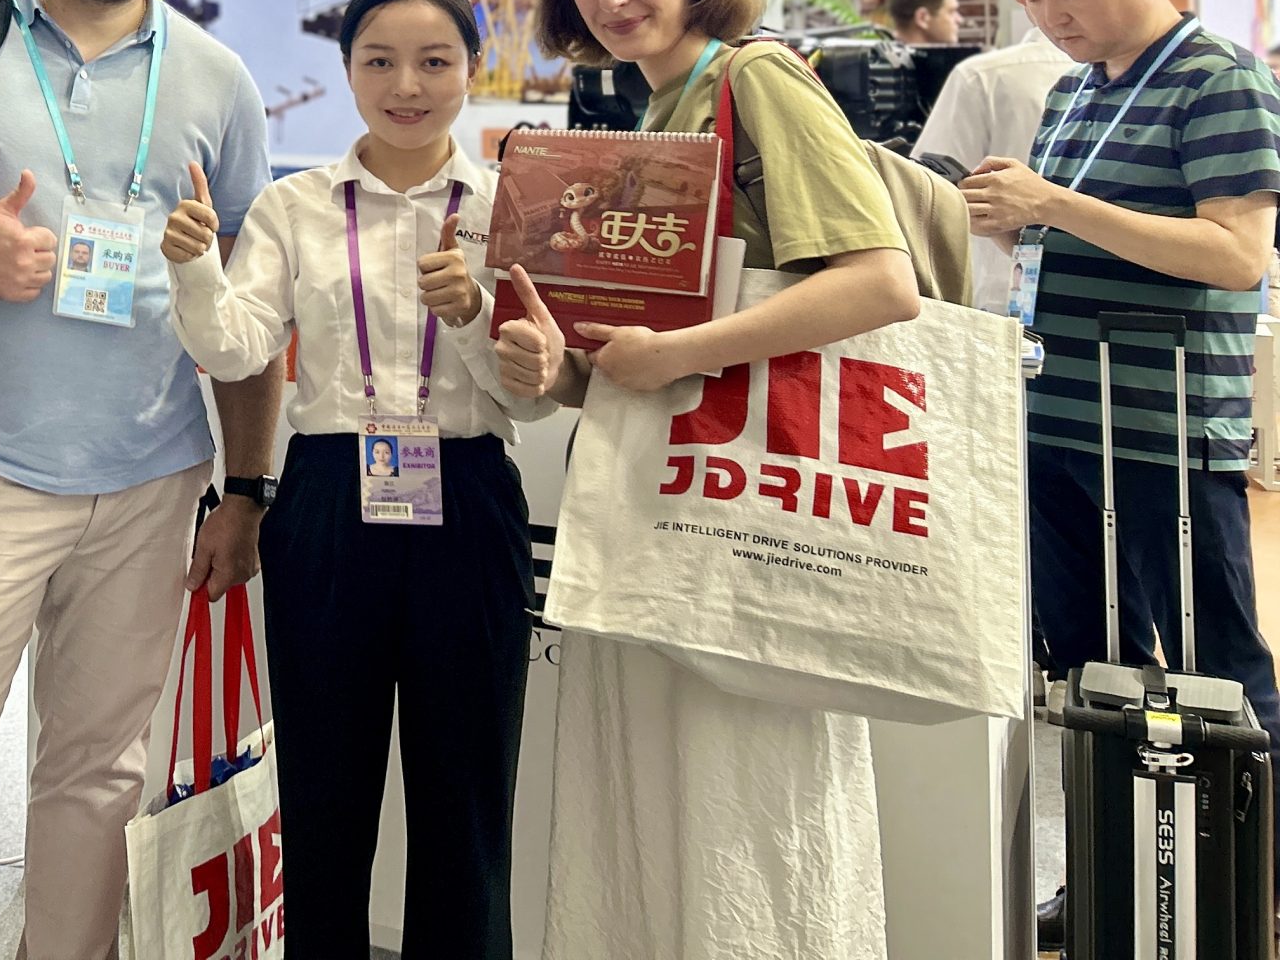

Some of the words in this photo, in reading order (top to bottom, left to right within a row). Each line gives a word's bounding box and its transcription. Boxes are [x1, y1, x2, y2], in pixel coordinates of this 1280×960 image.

[514, 145, 549, 156] NANTE
[455, 228, 490, 243] ANTE
[102, 249, 134, 262] 采购商
[103, 261, 130, 272] BUYER
[669, 350, 929, 480] JIE
[402, 462, 436, 470] EXHIBITOR
[659, 455, 929, 538] JDRIVE
[654, 521, 670, 530] JIE
[672, 522, 750, 543] INTELLIGENT
[752, 534, 789, 550] DRIVE
[793, 542, 862, 564] SOLUTIONS
[865, 556, 929, 577] PROVIDER
[732, 548, 842, 577] www.jiedrive.com
[1159, 876, 1172, 946] Airwheel
